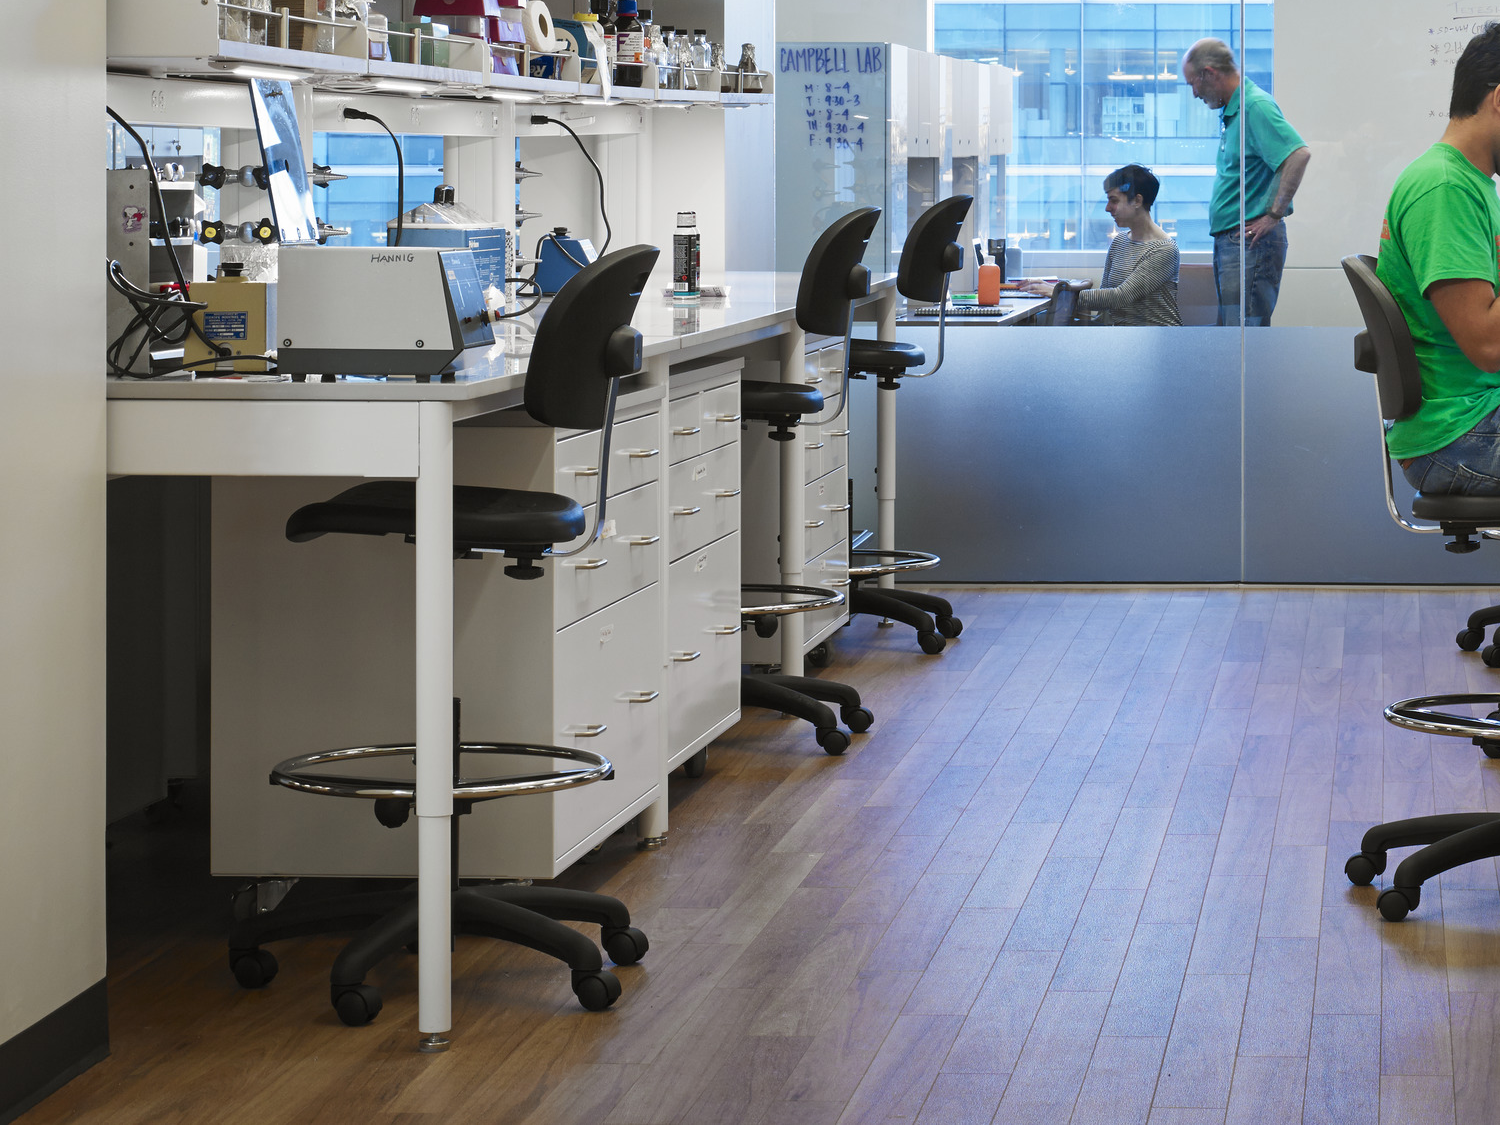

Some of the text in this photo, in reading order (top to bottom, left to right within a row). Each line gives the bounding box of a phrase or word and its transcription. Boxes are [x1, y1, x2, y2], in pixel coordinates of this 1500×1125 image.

[780, 46, 882, 74] CAMPBELL LAB
[370, 253, 415, 263] HANNIG
